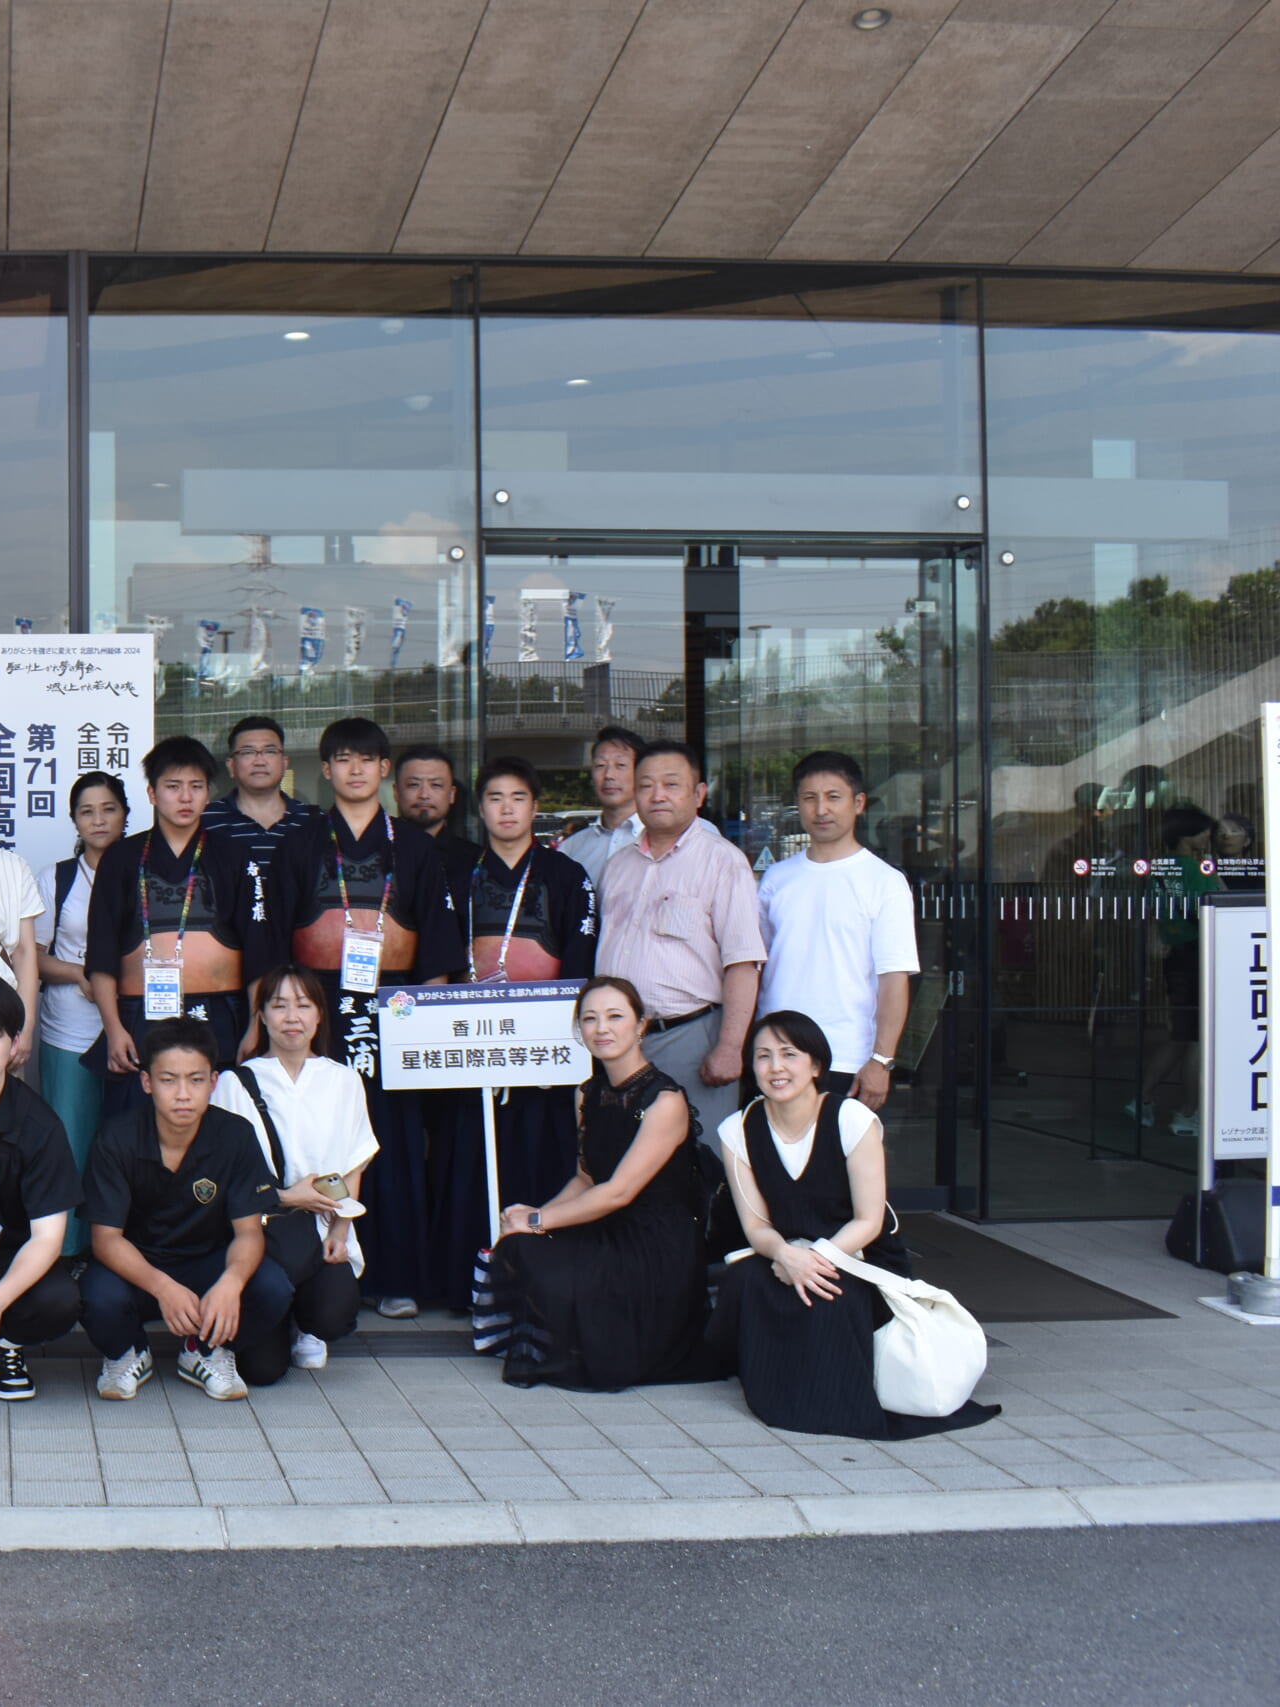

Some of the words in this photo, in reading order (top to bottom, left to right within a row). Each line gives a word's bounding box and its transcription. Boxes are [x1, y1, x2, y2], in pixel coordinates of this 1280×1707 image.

[77, 722, 101, 777] 全国
[106, 722, 130, 778] 令和
[23, 723, 57, 818] 第71回
[416, 988, 505, 1000] ありがとうを強さに変えて
[560, 986, 580, 995] 2024
[452, 1018, 516, 1037] 香川県
[401, 1045, 571, 1070] 星槎国際高等学校
